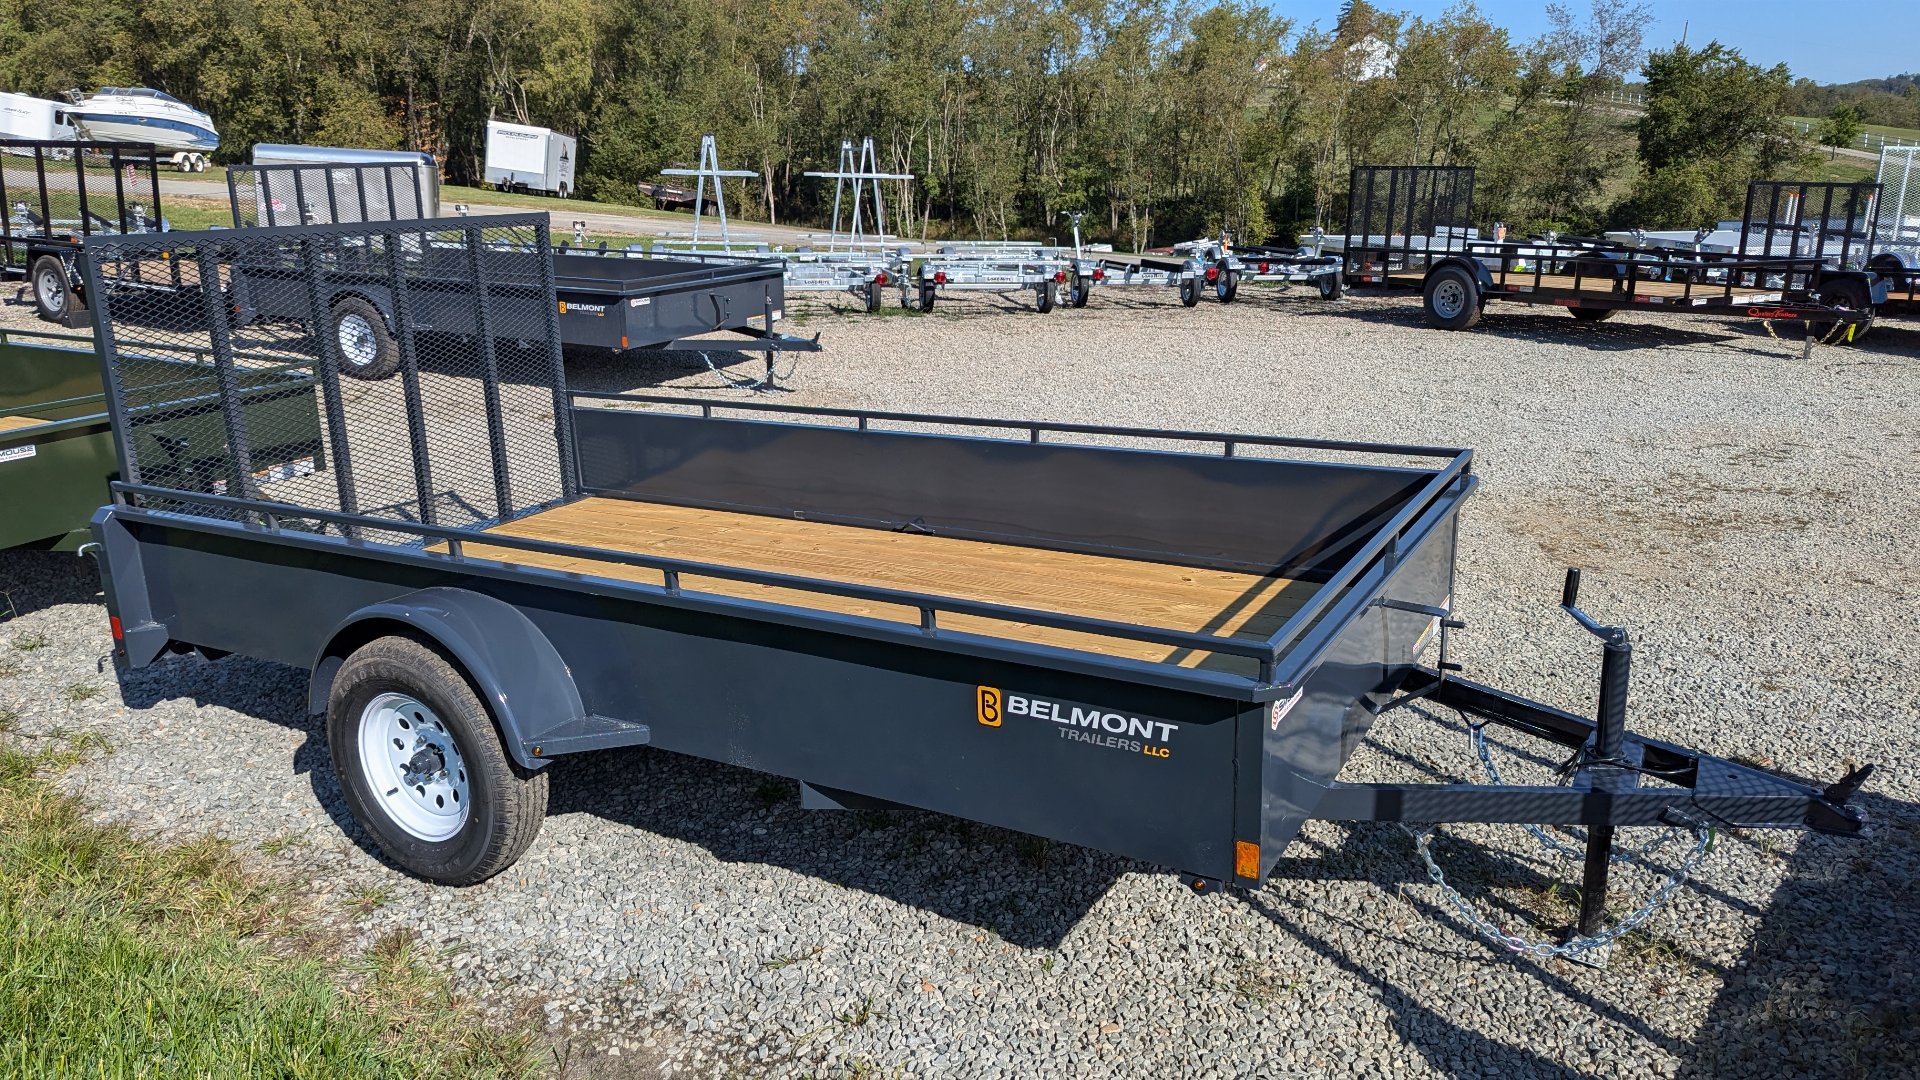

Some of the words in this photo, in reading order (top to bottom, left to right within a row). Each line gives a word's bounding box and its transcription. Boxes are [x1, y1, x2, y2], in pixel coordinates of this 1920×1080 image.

[567, 303, 605, 312] BELMONT
[1007, 695, 1178, 742] BELMONT
[1058, 726, 1141, 753] TRAILERS
[1143, 745, 1170, 758] LLC
